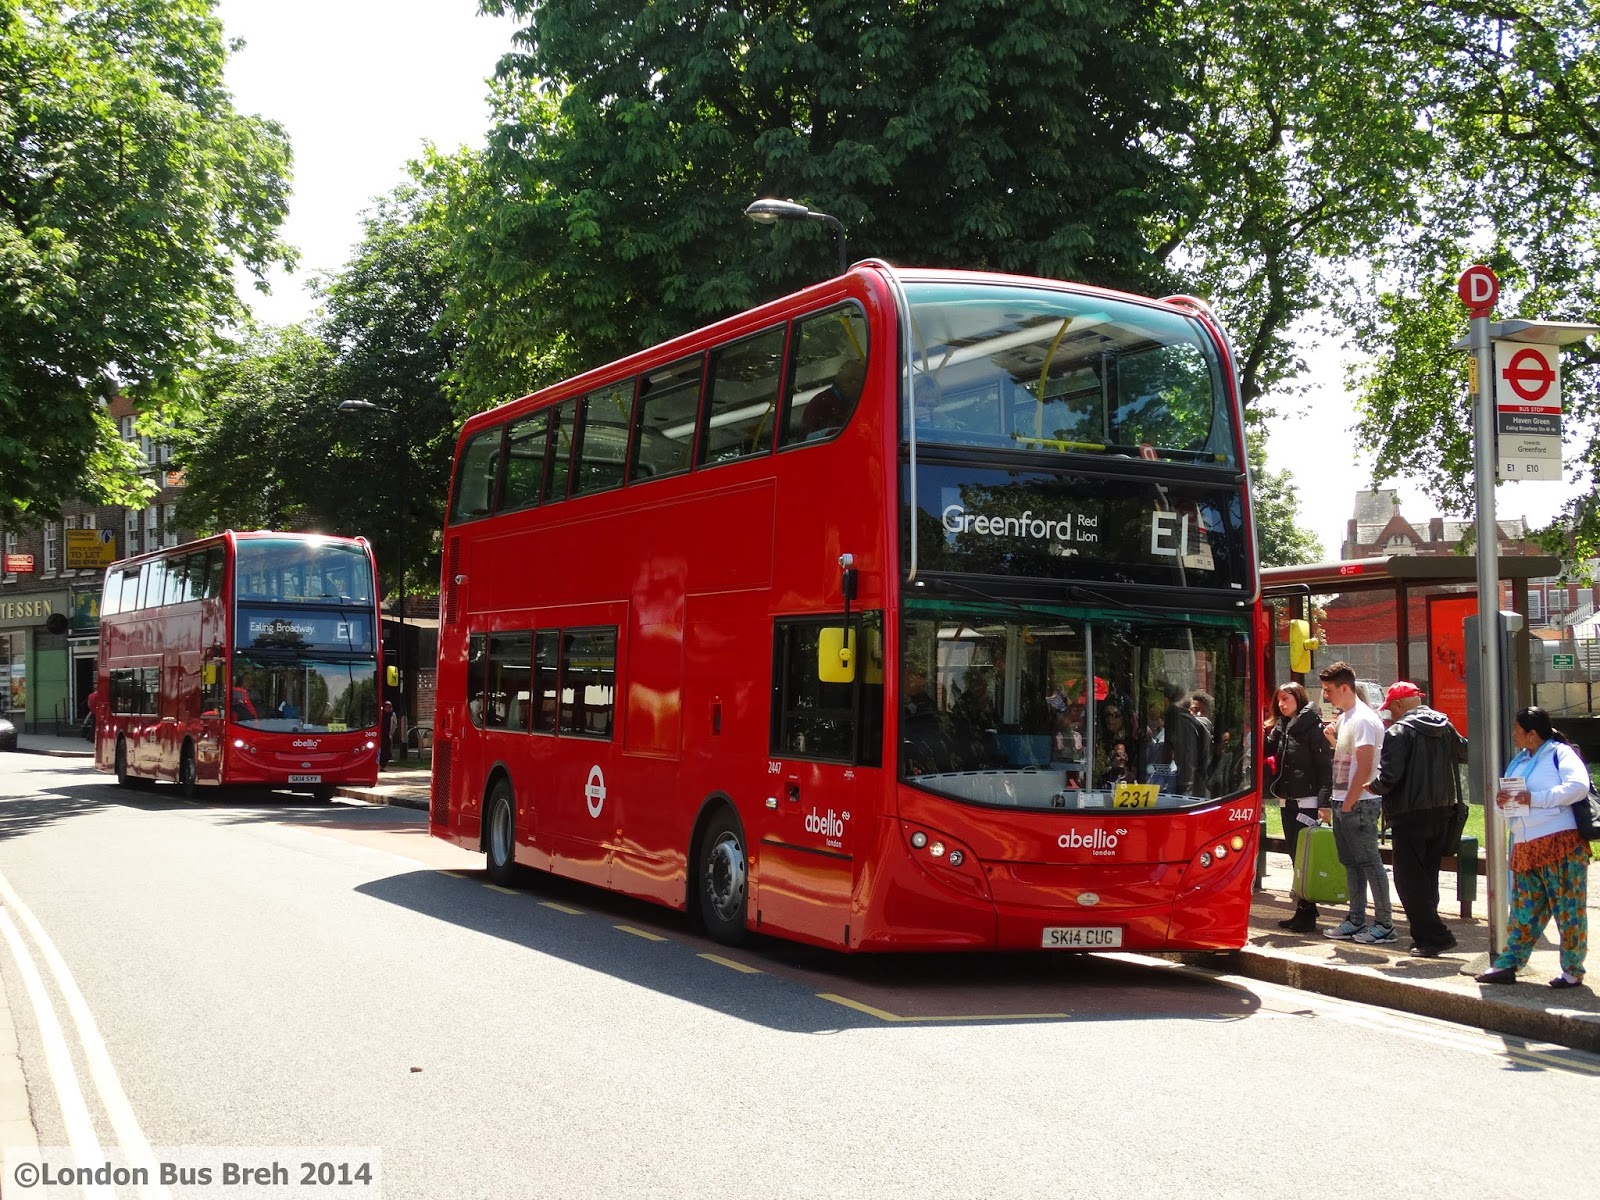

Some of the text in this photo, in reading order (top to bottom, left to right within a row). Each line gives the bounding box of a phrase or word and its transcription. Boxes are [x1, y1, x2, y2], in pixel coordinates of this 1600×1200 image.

[1470, 273, 1494, 302] D
[1512, 416, 1551, 425] Haven Green
[1517, 445, 1547, 453] Greenford
[1506, 463, 1539, 472] E1 E10
[942, 504, 1071, 541] Greenford
[1077, 514, 1098, 527] Red
[1076, 529, 1098, 543] Lion
[1151, 510, 1189, 557] E1
[85, 551, 102, 559] LET
[250, 622, 316, 635] Ealing Broadway
[292, 739, 318, 747] abellio
[768, 761, 781, 774] 2447
[1118, 791, 1150, 808] 231
[1228, 808, 1254, 822] 2447
[804, 806, 844, 838] abellio
[826, 838, 842, 848] london
[1057, 828, 1119, 849] abellio
[1050, 929, 1113, 945] SK14 CUG
